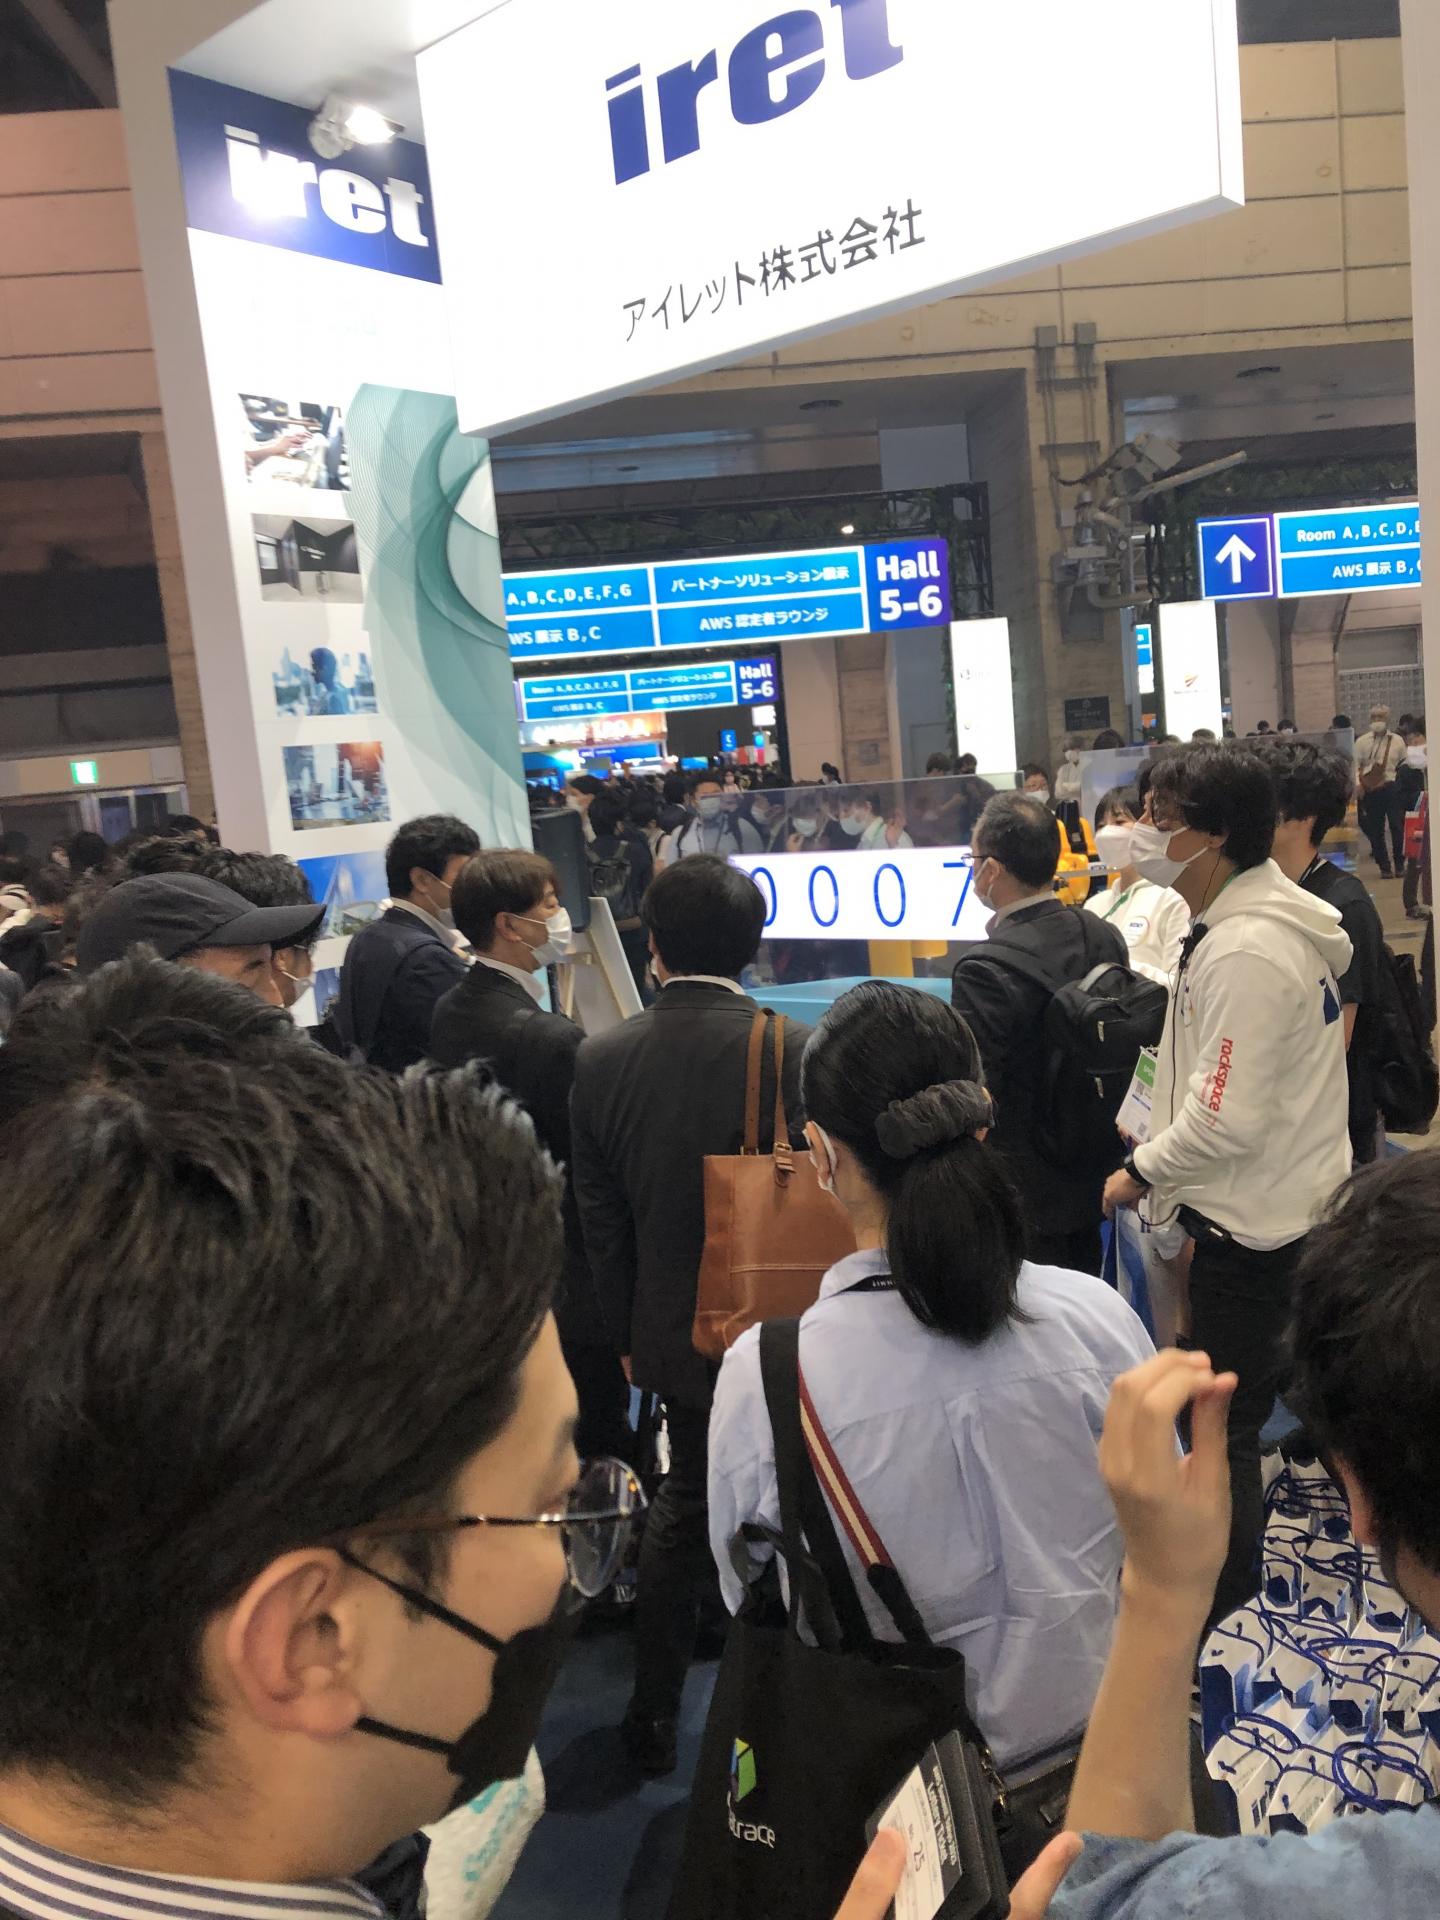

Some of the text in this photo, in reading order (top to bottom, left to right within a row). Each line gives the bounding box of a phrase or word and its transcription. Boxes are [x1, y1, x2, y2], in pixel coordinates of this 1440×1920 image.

[605, 0, 904, 185] iret
[224, 124, 429, 247] iret
[623, 198, 926, 342] アイレット株式会社
[1297, 529, 1336, 542] Room
[876, 550, 941, 582] Hall
[1332, 563, 1364, 579] AWS
[507, 583, 632, 607] A,B,C,D,E,F,G
[879, 585, 943, 621] 5-6
[566, 626, 602, 643] B,C
[699, 616, 733, 631] AWS
[739, 663, 773, 680] Hall
[741, 680, 775, 699] 5-6
[1209, 1038, 1233, 1112] rackspace
